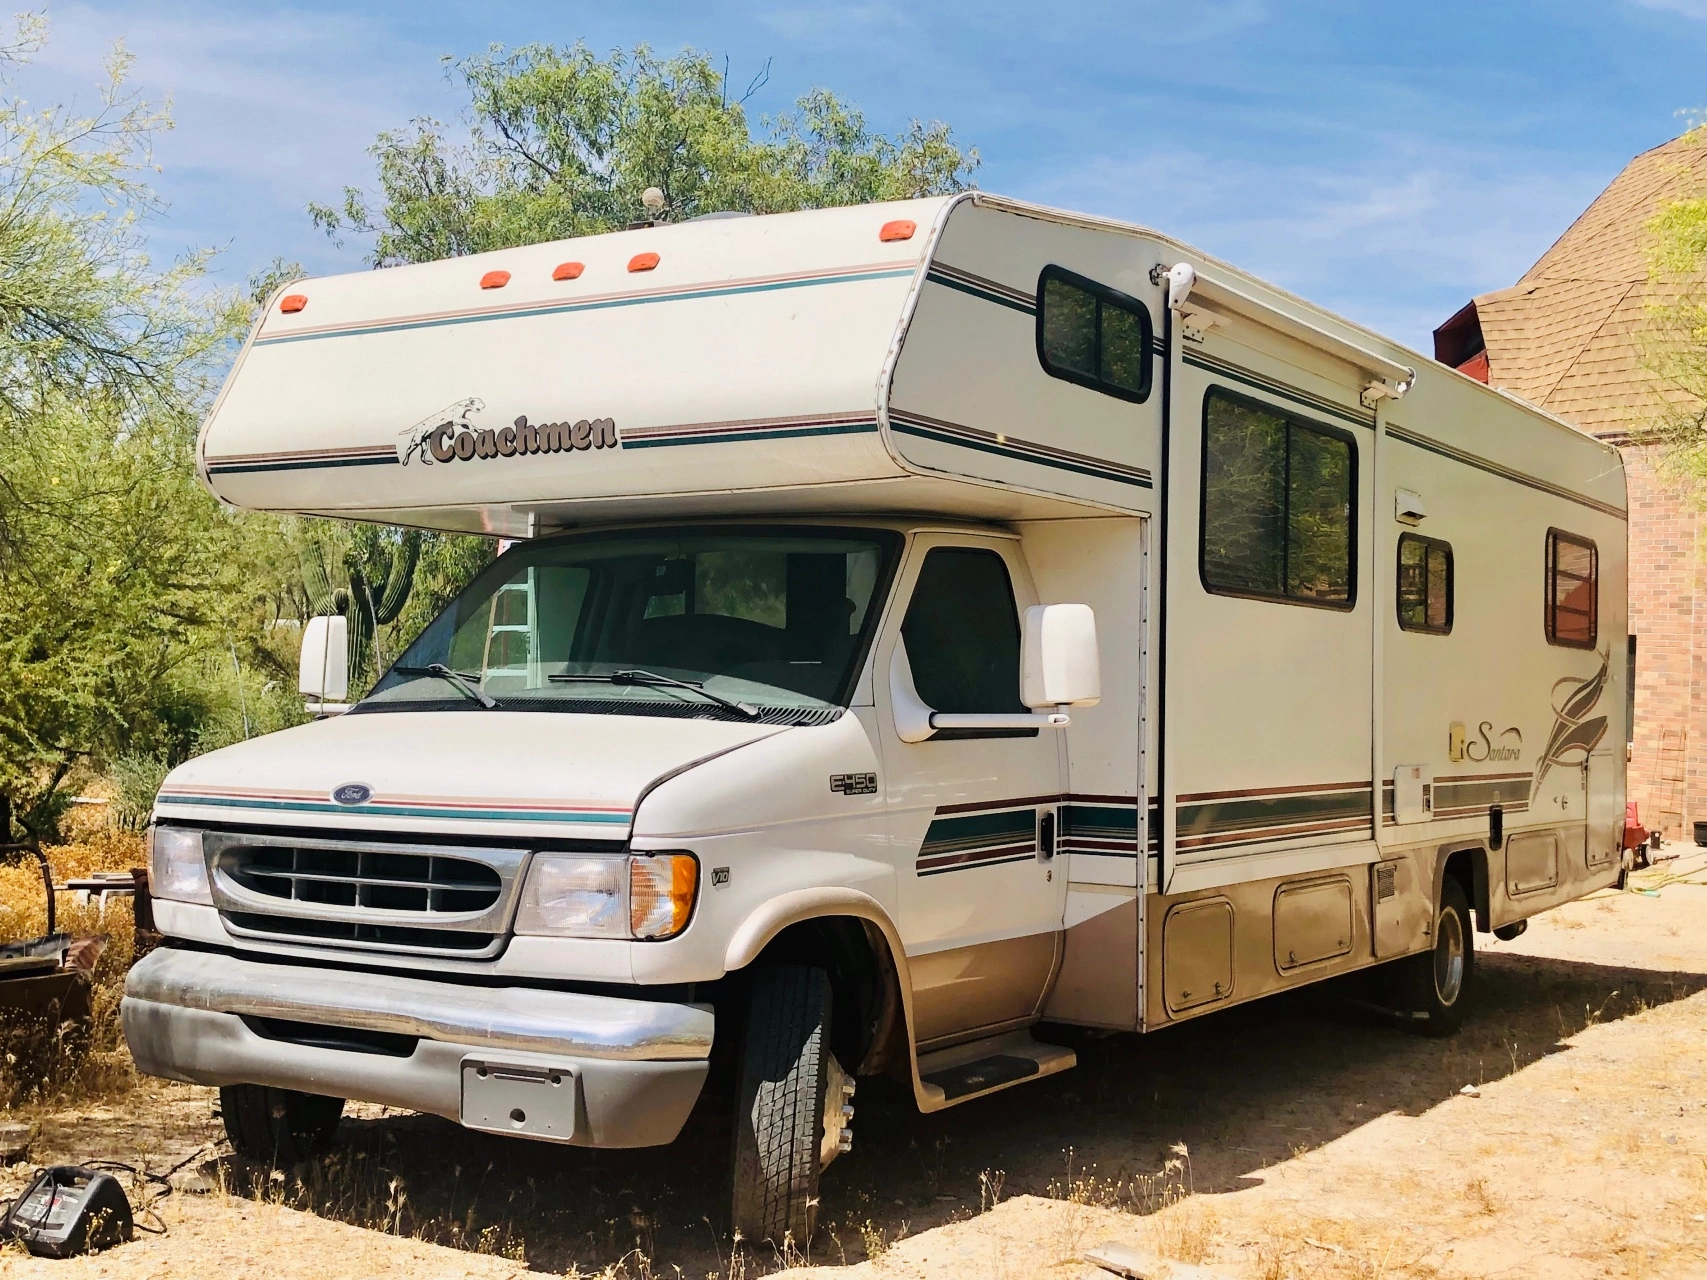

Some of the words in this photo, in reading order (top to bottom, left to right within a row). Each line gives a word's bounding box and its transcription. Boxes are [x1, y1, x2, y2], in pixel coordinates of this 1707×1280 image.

[430, 415, 617, 464] Coachmen
[1466, 721, 1521, 763] Santara
[341, 787, 364, 799] Ford
[711, 871, 728, 886] V10
